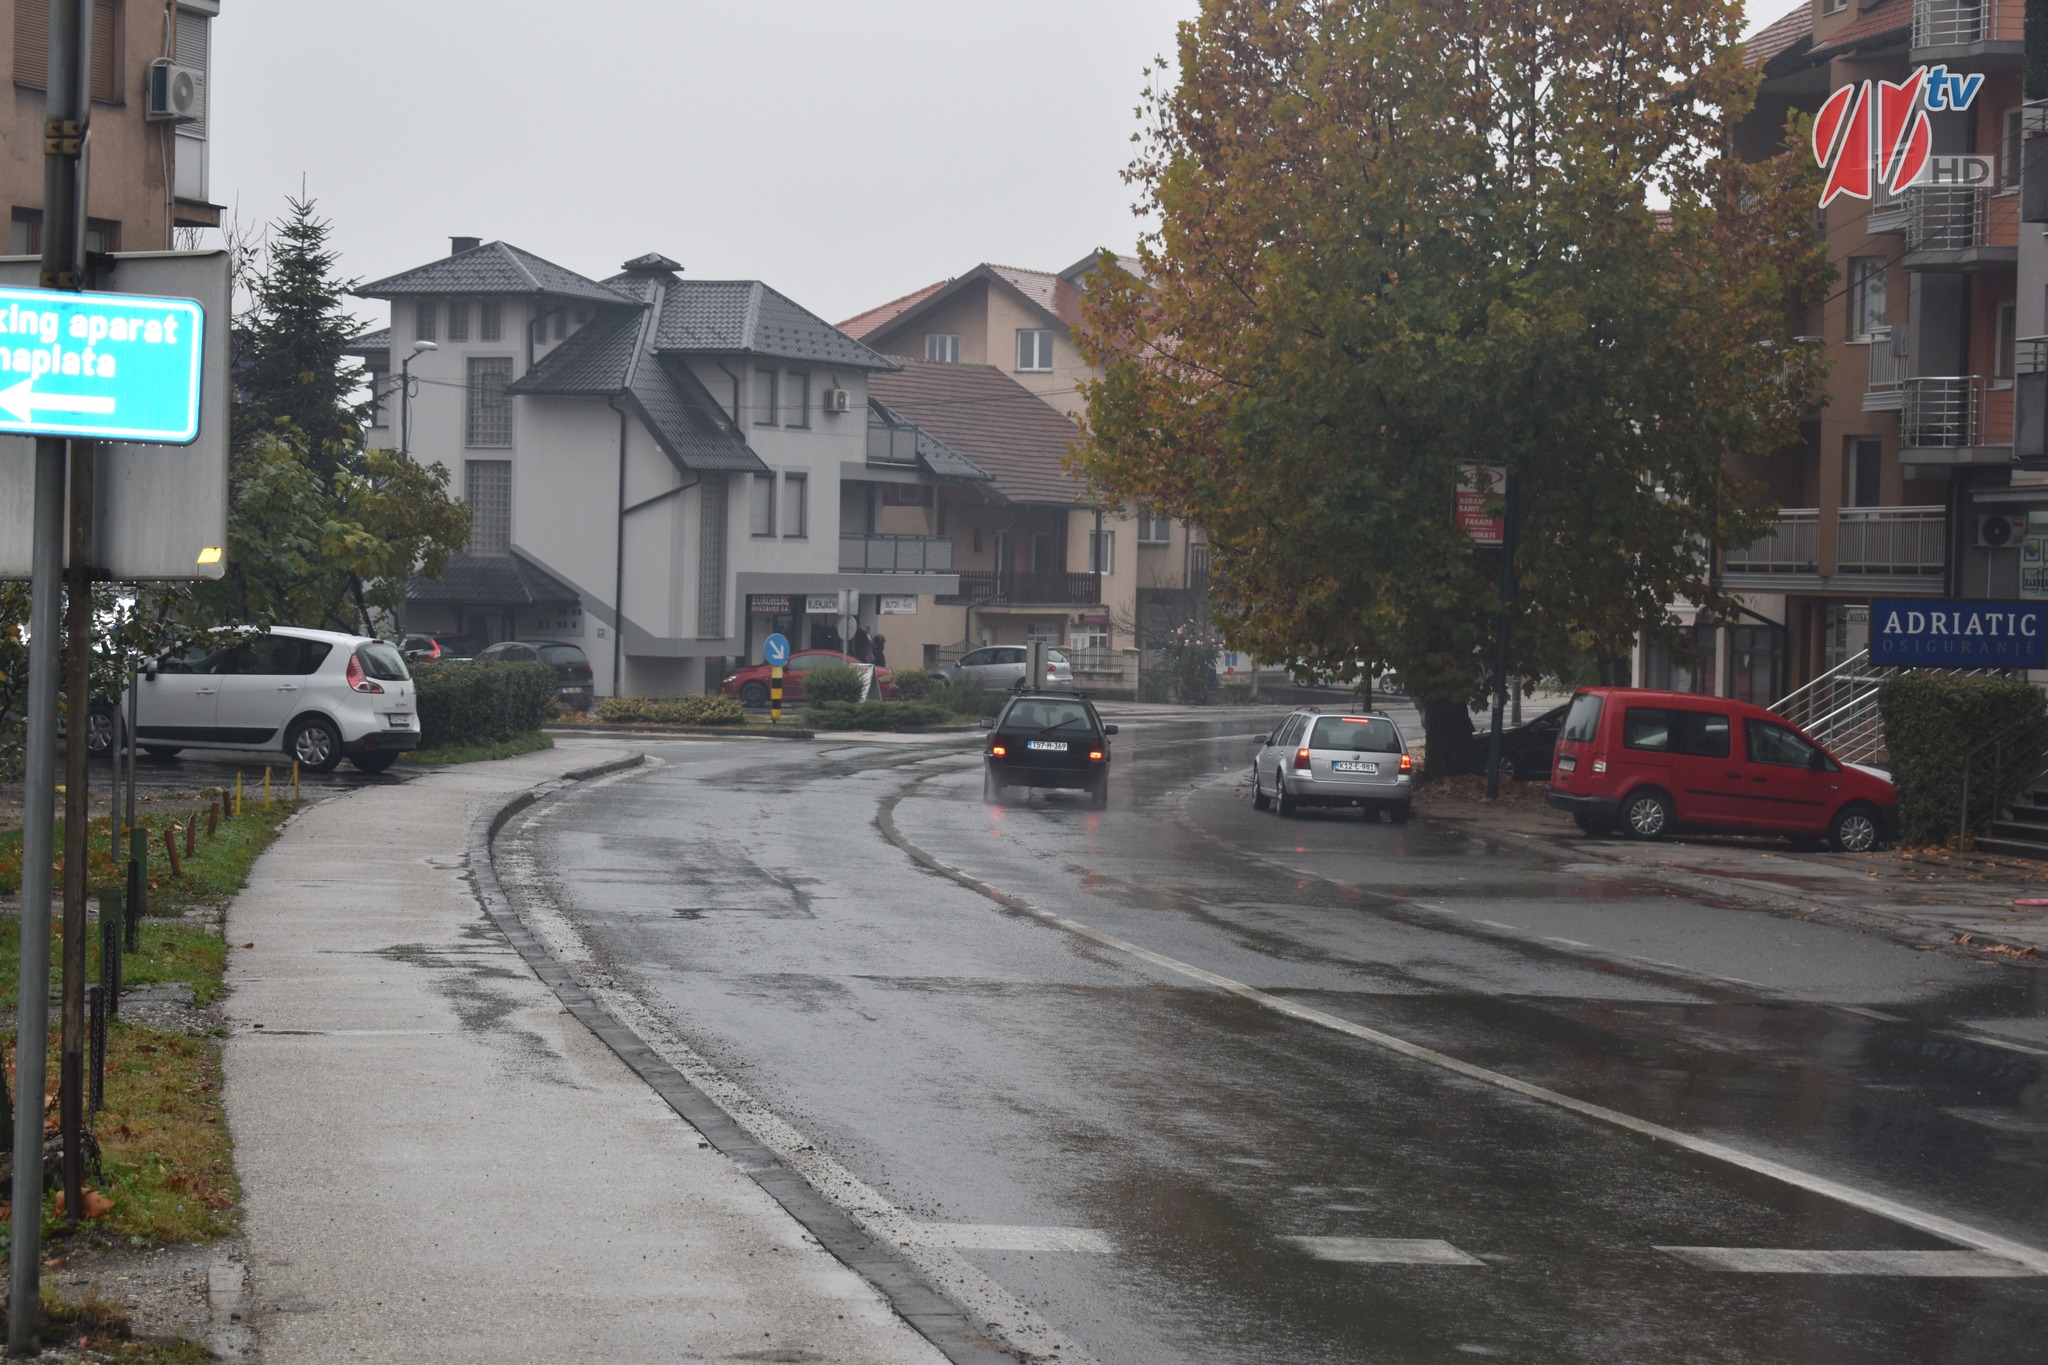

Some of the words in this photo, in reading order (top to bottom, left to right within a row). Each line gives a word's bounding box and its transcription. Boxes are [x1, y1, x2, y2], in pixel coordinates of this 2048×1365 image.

[69, 314, 179, 346] aparat
[752, 595, 790, 605] EUROHERC
[1883, 610, 2037, 637] ADRIATIC
[1882, 639, 2036, 656] OSIGURANJE
